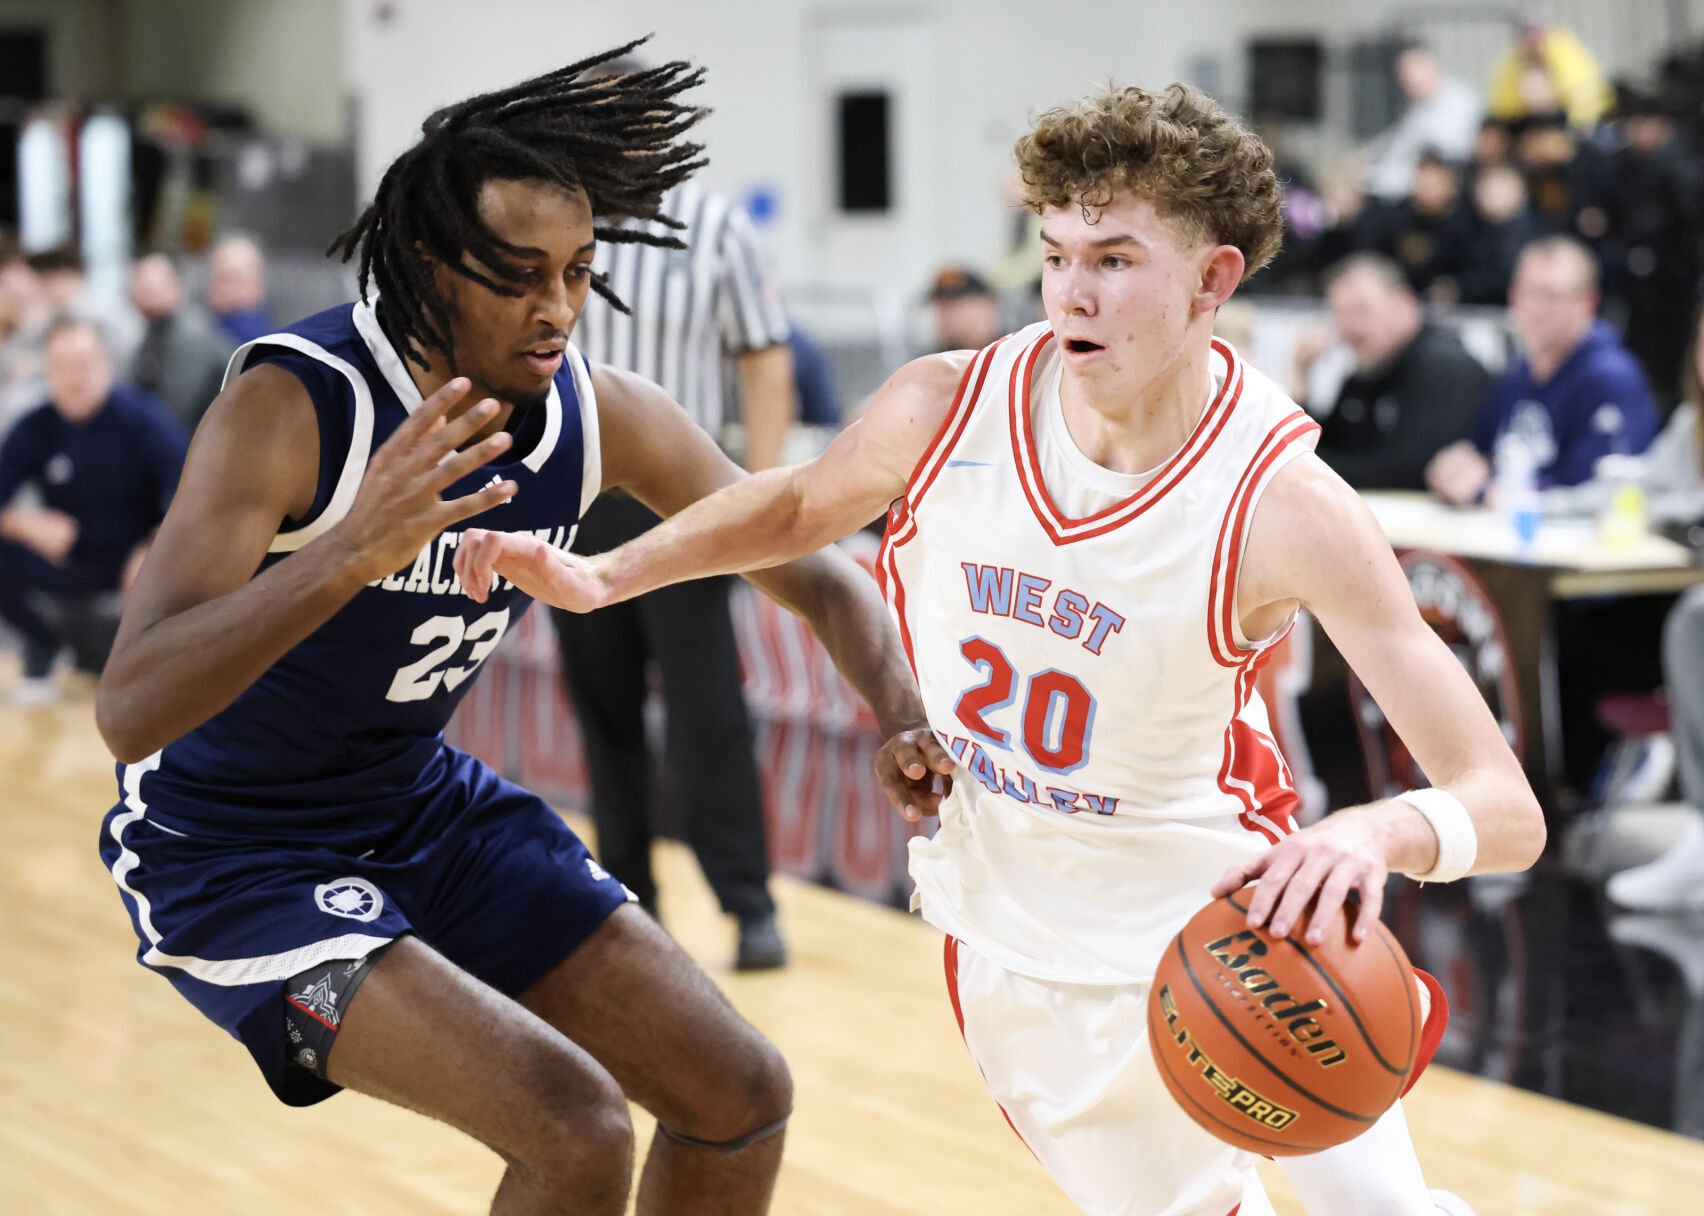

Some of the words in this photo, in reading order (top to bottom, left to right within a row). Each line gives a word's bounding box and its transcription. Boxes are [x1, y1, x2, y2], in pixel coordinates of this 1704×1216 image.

[385, 607, 510, 703] 23
[961, 562, 1126, 656] WEST
[953, 634, 1098, 776] 20
[1203, 929, 1347, 1067] Baden
